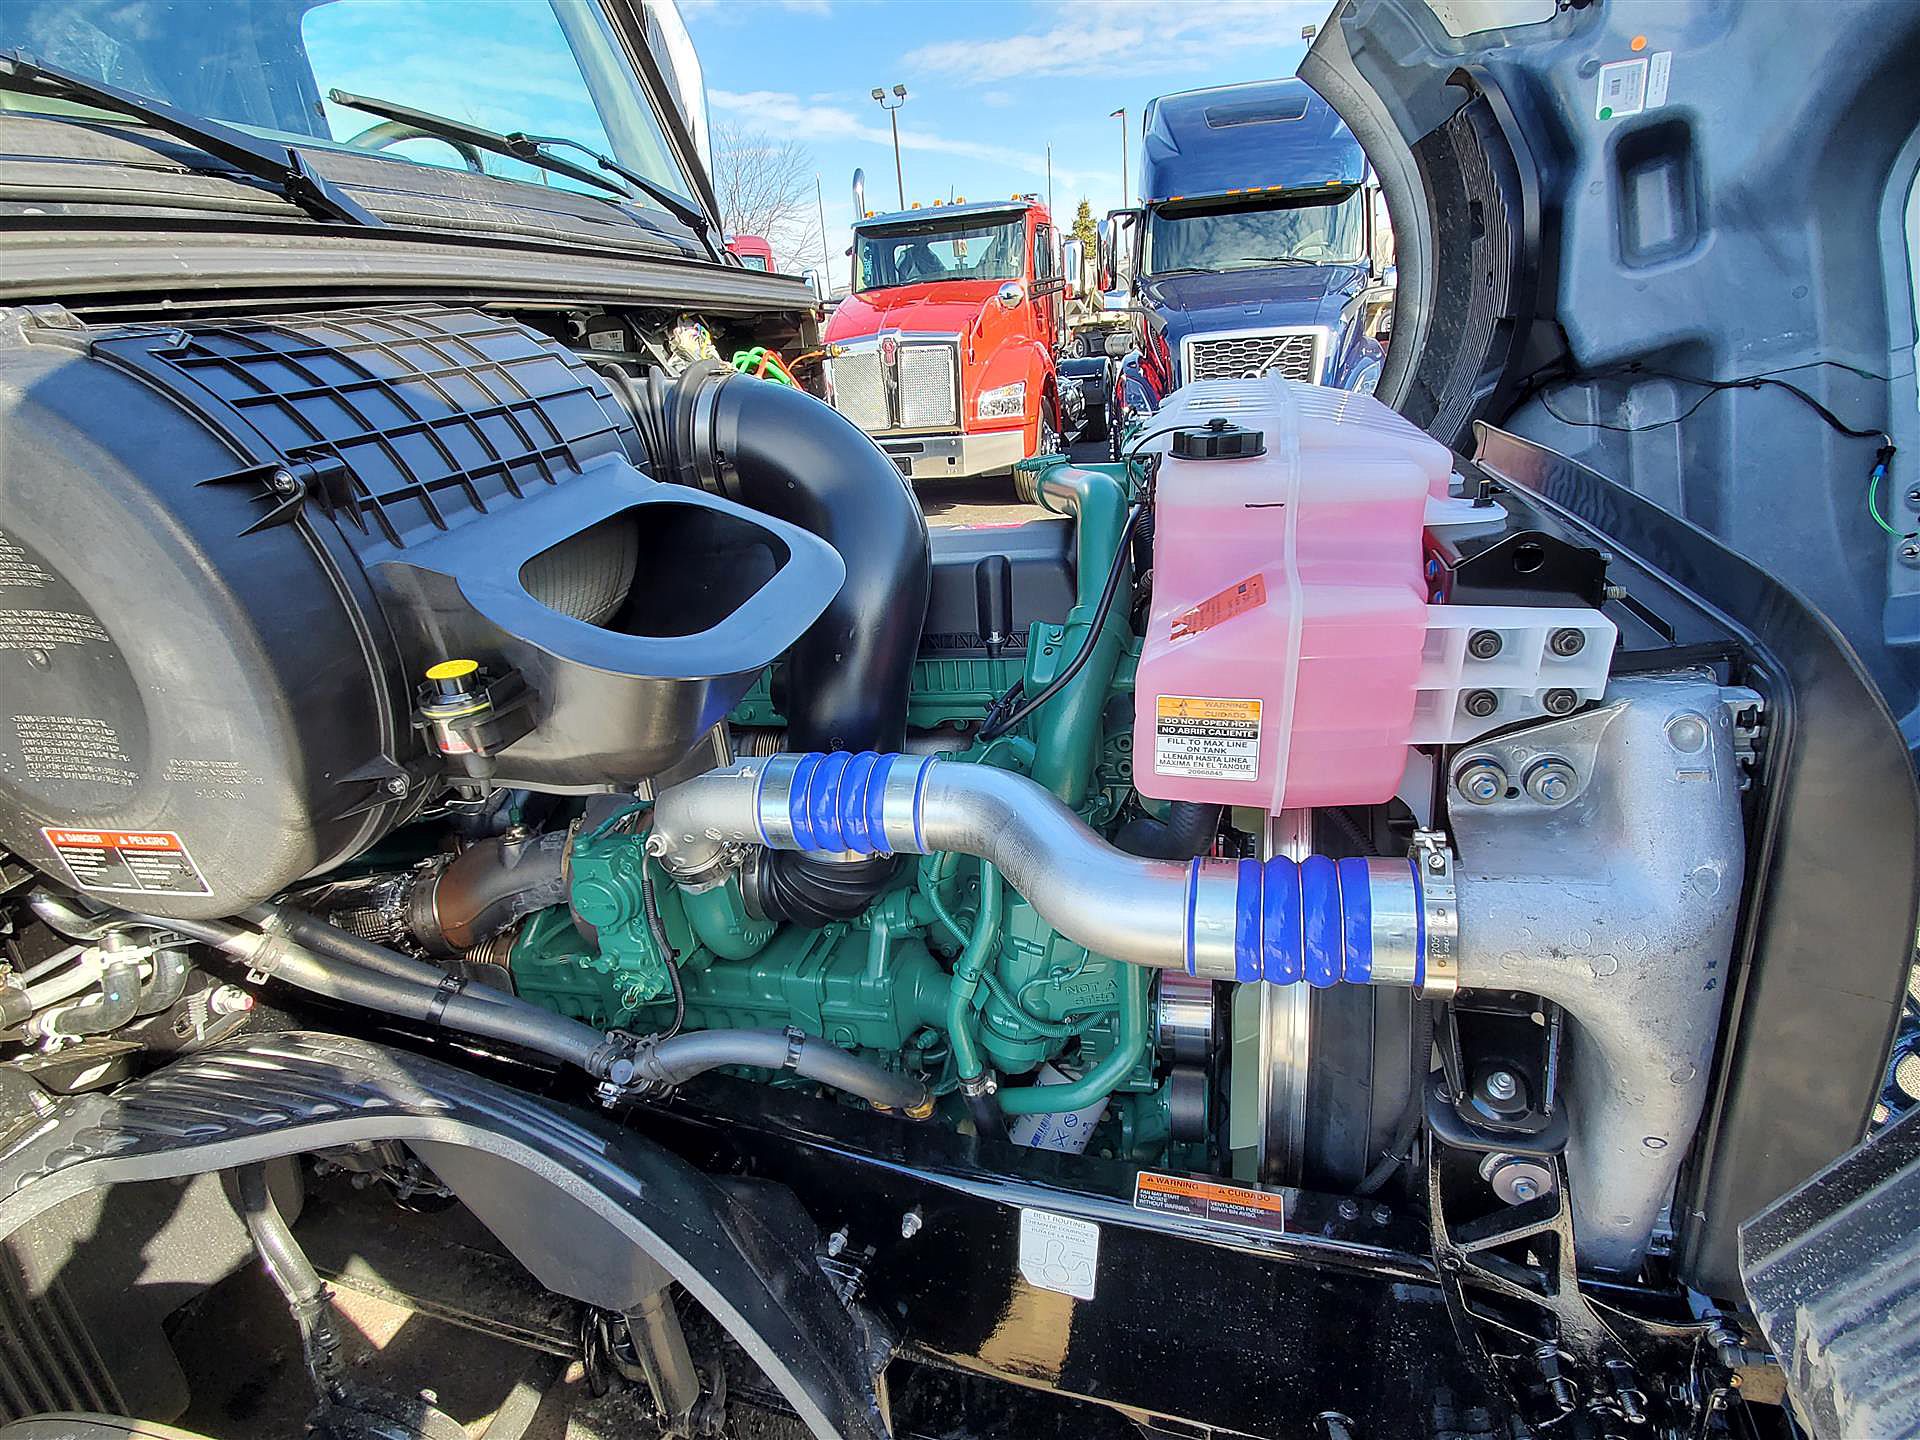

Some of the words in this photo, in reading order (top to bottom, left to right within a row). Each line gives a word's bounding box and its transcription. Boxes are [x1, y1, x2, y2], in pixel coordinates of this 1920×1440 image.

[1204, 701, 1249, 709] WARNING
[1204, 711, 1247, 719] CUIDADO
[1208, 729, 1254, 738] CALIENTE
[1167, 737, 1185, 745] FILL
[1163, 753, 1194, 761] LLENAR
[1195, 754, 1222, 762] HASTA
[1159, 759, 1191, 767] MAXIMA
[1218, 763, 1251, 771] TANQUE
[65, 834, 103, 843] DANGER
[1065, 982, 1099, 994] NOT
[1106, 978, 1118, 989] A
[1156, 1177, 1199, 1190] WARNING
[1148, 1195, 1167, 1203] ROTATE
[1227, 1189, 1271, 1202] CUIDADO
[1139, 1199, 1164, 1208] WITHOUT
[1210, 1201, 1245, 1212] VENTILADOR
